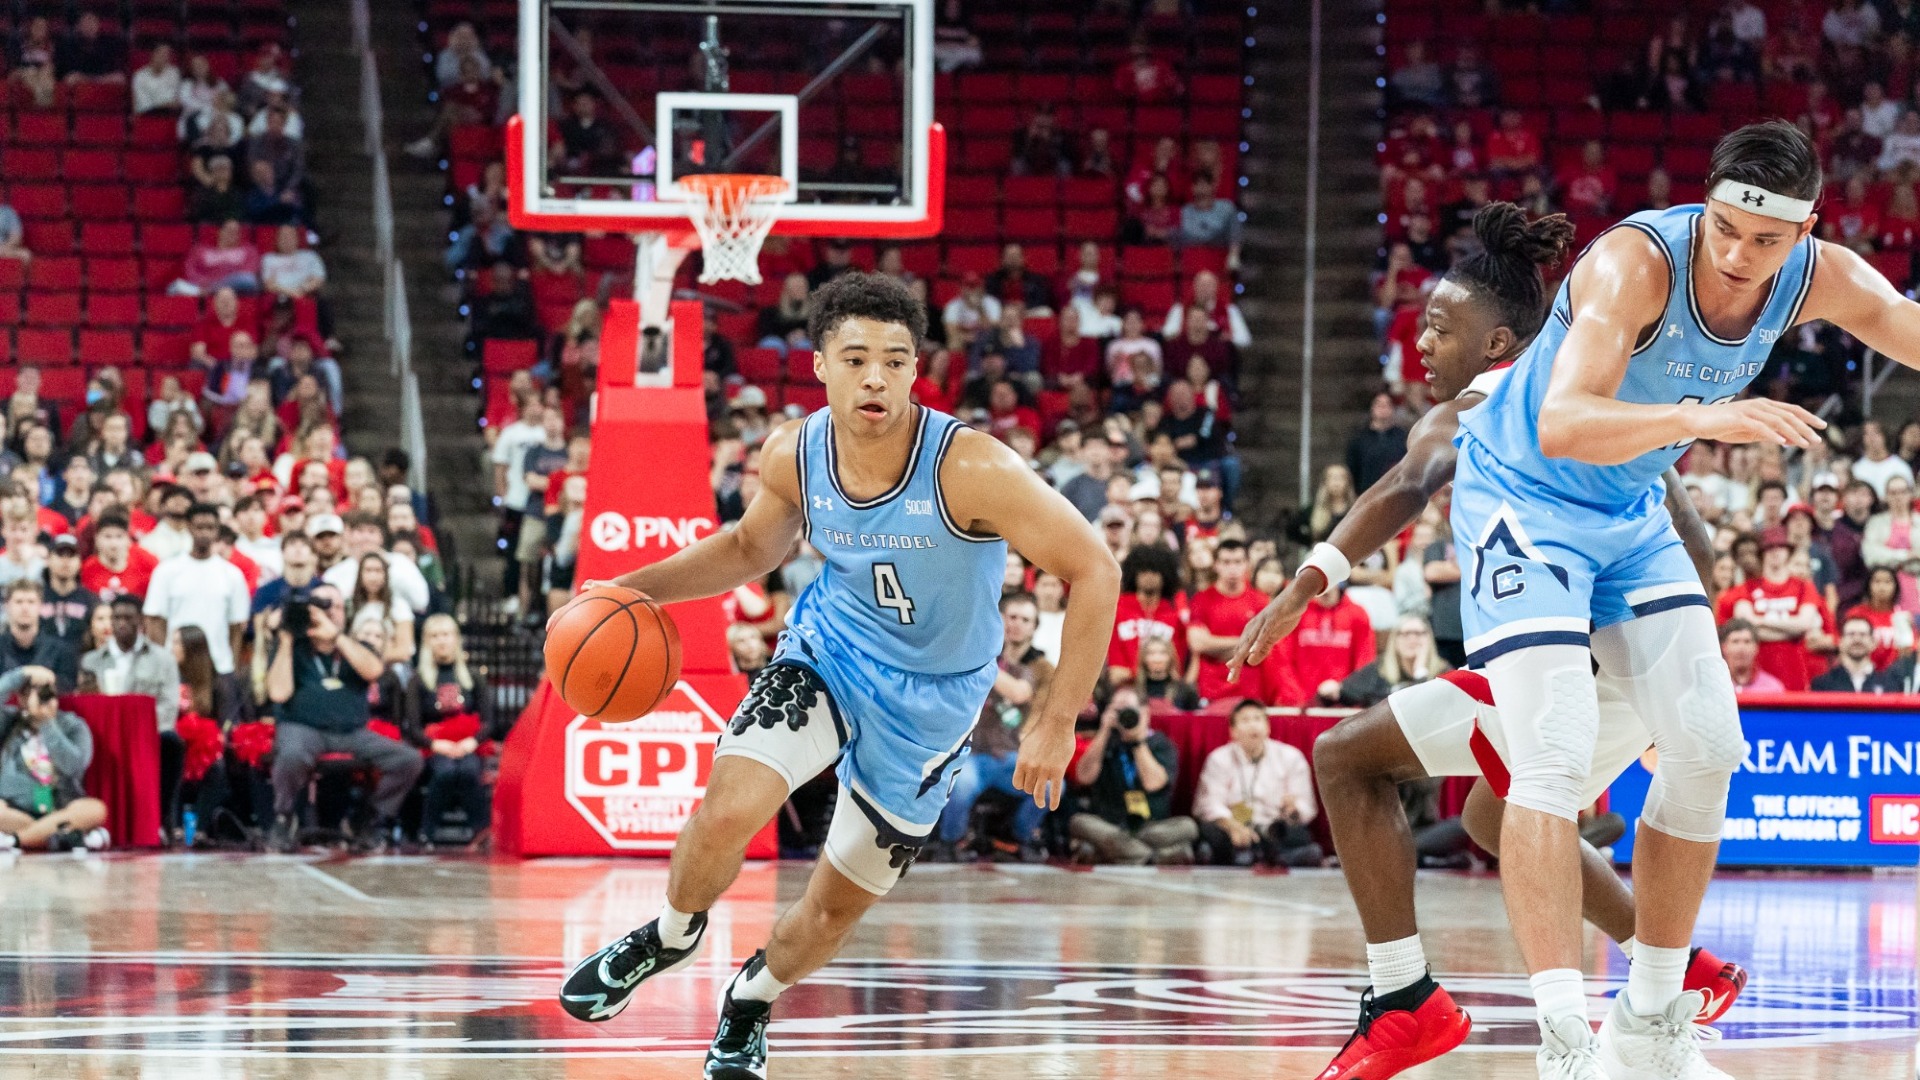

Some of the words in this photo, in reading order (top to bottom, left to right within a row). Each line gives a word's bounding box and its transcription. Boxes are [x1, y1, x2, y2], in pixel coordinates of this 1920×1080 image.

[1759, 328, 1780, 344] SOC
[1665, 361, 1695, 378] THE
[905, 499, 932, 516] SOCON
[633, 515, 713, 549] PNC
[822, 527, 855, 546] THE
[859, 533, 938, 550] CITADEL
[872, 562, 916, 625] 4
[583, 740, 715, 787] CPI
[1732, 739, 1838, 774] REAM
[604, 796, 694, 817] SECURITY
[1752, 794, 1786, 818] THE
[1787, 795, 1861, 819] OFFICIAL
[1758, 818, 1837, 841] SPONSOR
[1838, 818, 1861, 841] OF
[1882, 803, 1920, 836] NC
